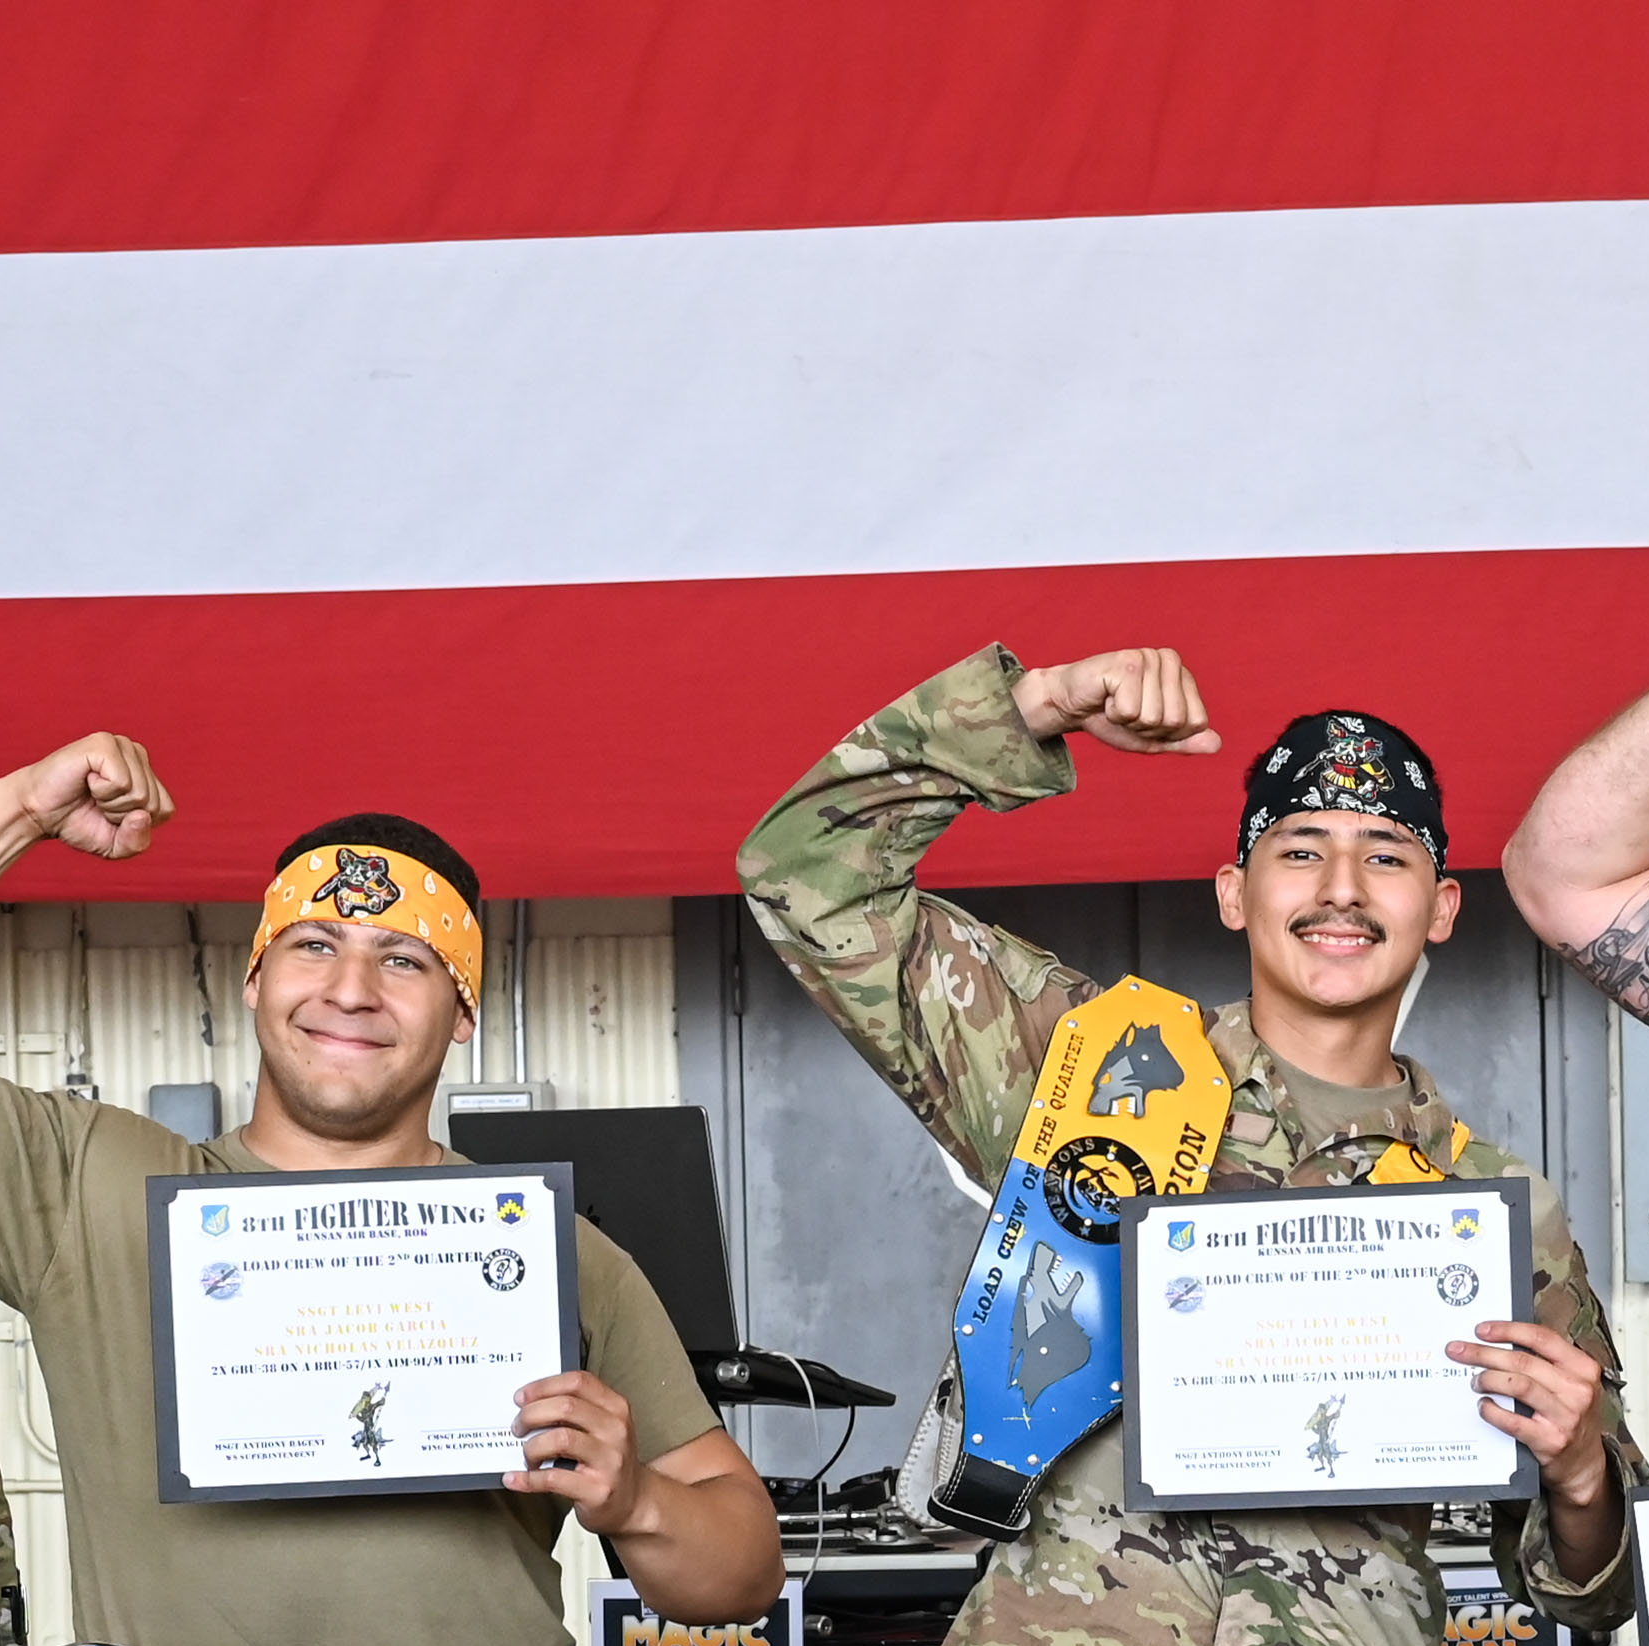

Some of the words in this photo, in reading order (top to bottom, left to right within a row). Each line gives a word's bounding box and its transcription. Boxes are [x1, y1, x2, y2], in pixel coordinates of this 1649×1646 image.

[1164, 1122, 1208, 1195] PION
[974, 1266, 1003, 1324] LOAD
[997, 1196, 1029, 1260] CREW
[1023, 1162, 1041, 1190] OF
[1034, 1116, 1057, 1156] THE
[1050, 1033, 1085, 1111] QUARTER
[242, 1216, 285, 1232] 8TH
[295, 1198, 409, 1230] FIGHTER
[417, 1203, 485, 1225] WING
[297, 1232, 342, 1242] KUNSAN
[347, 1231, 366, 1240] AIR
[369, 1229, 401, 1240] BASE,
[1207, 1232, 1247, 1248] 8TH
[1257, 1215, 1366, 1245] FIGHTER
[1375, 1218, 1440, 1240] WING
[243, 1260, 280, 1272] LOAD
[285, 1258, 325, 1270] CREW
[331, 1257, 350, 1268] OF
[355, 1255, 383, 1268] THE
[414, 1251, 483, 1265] QUARTER
[1258, 1247, 1301, 1256] KUNSAN
[1305, 1246, 1324, 1254] AIR
[1206, 1274, 1241, 1285] LOAD
[1246, 1272, 1284, 1284] CREW
[1290, 1271, 1307, 1282] OF
[1311, 1270, 1340, 1281] THE
[1371, 1266, 1438, 1279] QUARTER
[281, 1361, 298, 1373] ON
[302, 1361, 311, 1372] A
[446, 1354, 479, 1366] TIME
[489, 1352, 524, 1364] 20:17
[1239, 1373, 1256, 1384] ON
[1401, 1368, 1432, 1379] TIME
[1464, 1593, 1490, 1601] TALENT
[1444, 1602, 1538, 1640] GIC
